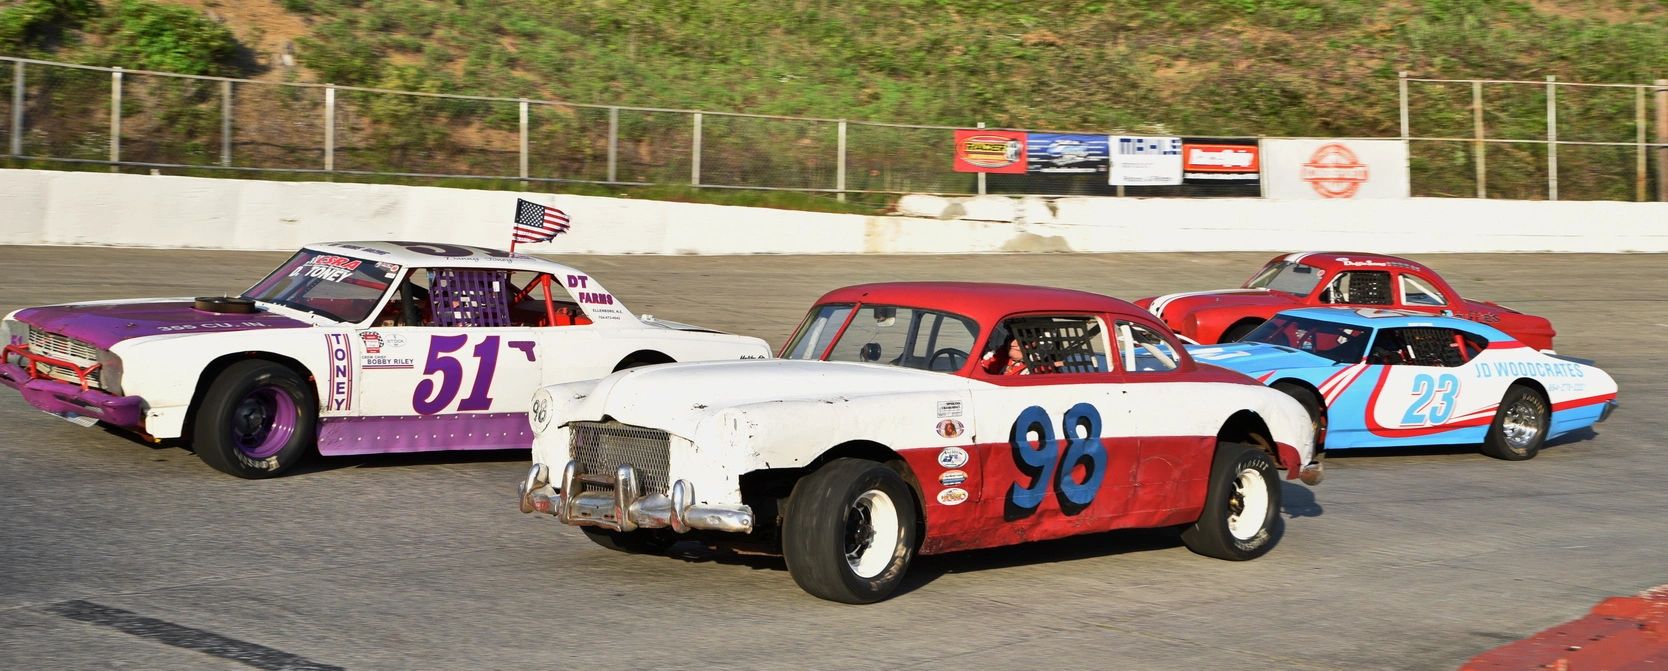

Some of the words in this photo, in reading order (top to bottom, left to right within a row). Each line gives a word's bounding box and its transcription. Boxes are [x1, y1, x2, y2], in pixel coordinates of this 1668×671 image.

[304, 264, 354, 283] TONEY
[567, 274, 588, 289] DT
[578, 292, 614, 305] FARMS
[331, 333, 347, 411] TONEY
[412, 333, 501, 416] 51
[1475, 362, 1491, 379] JD
[1493, 361, 1584, 379] WOODCRATES
[532, 397, 548, 424] 98
[1400, 373, 1461, 427] 23
[1003, 402, 1109, 523] 98
